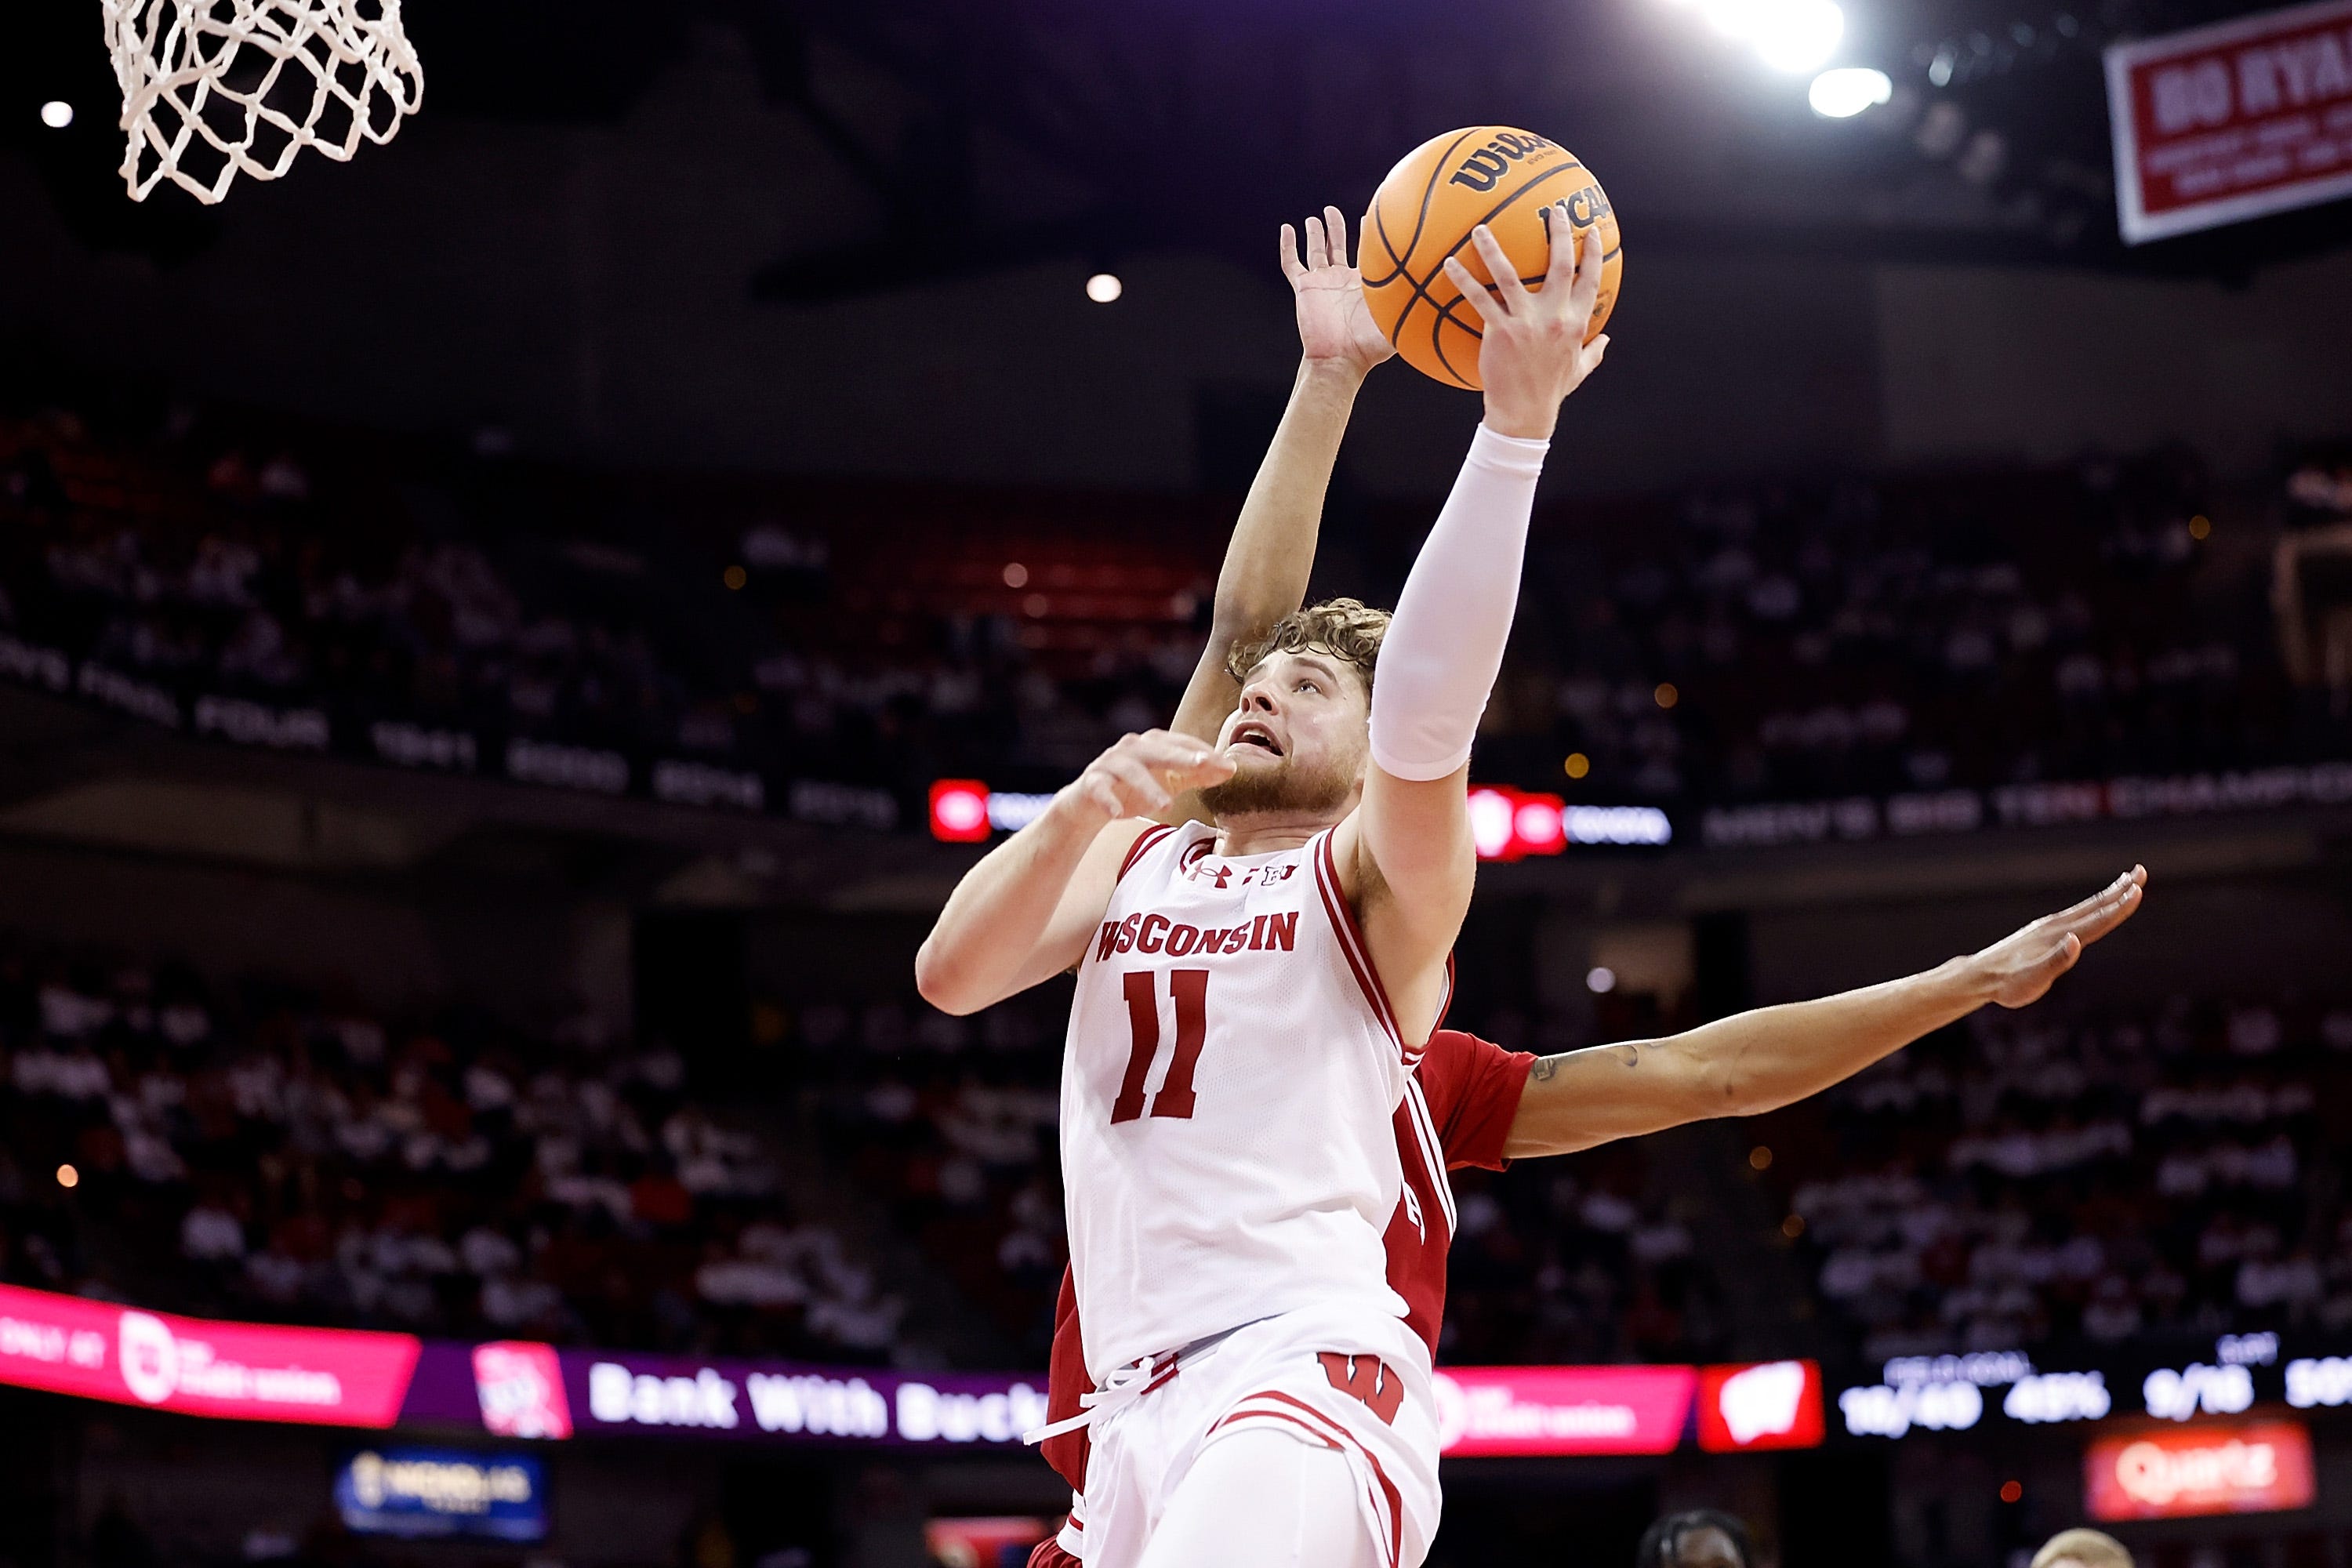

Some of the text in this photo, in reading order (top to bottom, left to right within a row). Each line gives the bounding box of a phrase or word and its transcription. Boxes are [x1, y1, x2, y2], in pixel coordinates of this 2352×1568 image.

[2238, 31, 2352, 116] RYA
[1096, 912, 1299, 963] WSCONSIN
[1110, 969, 1210, 1125] 11
[590, 1362, 739, 1428] Bank
[896, 1382, 1049, 1442] Buck
